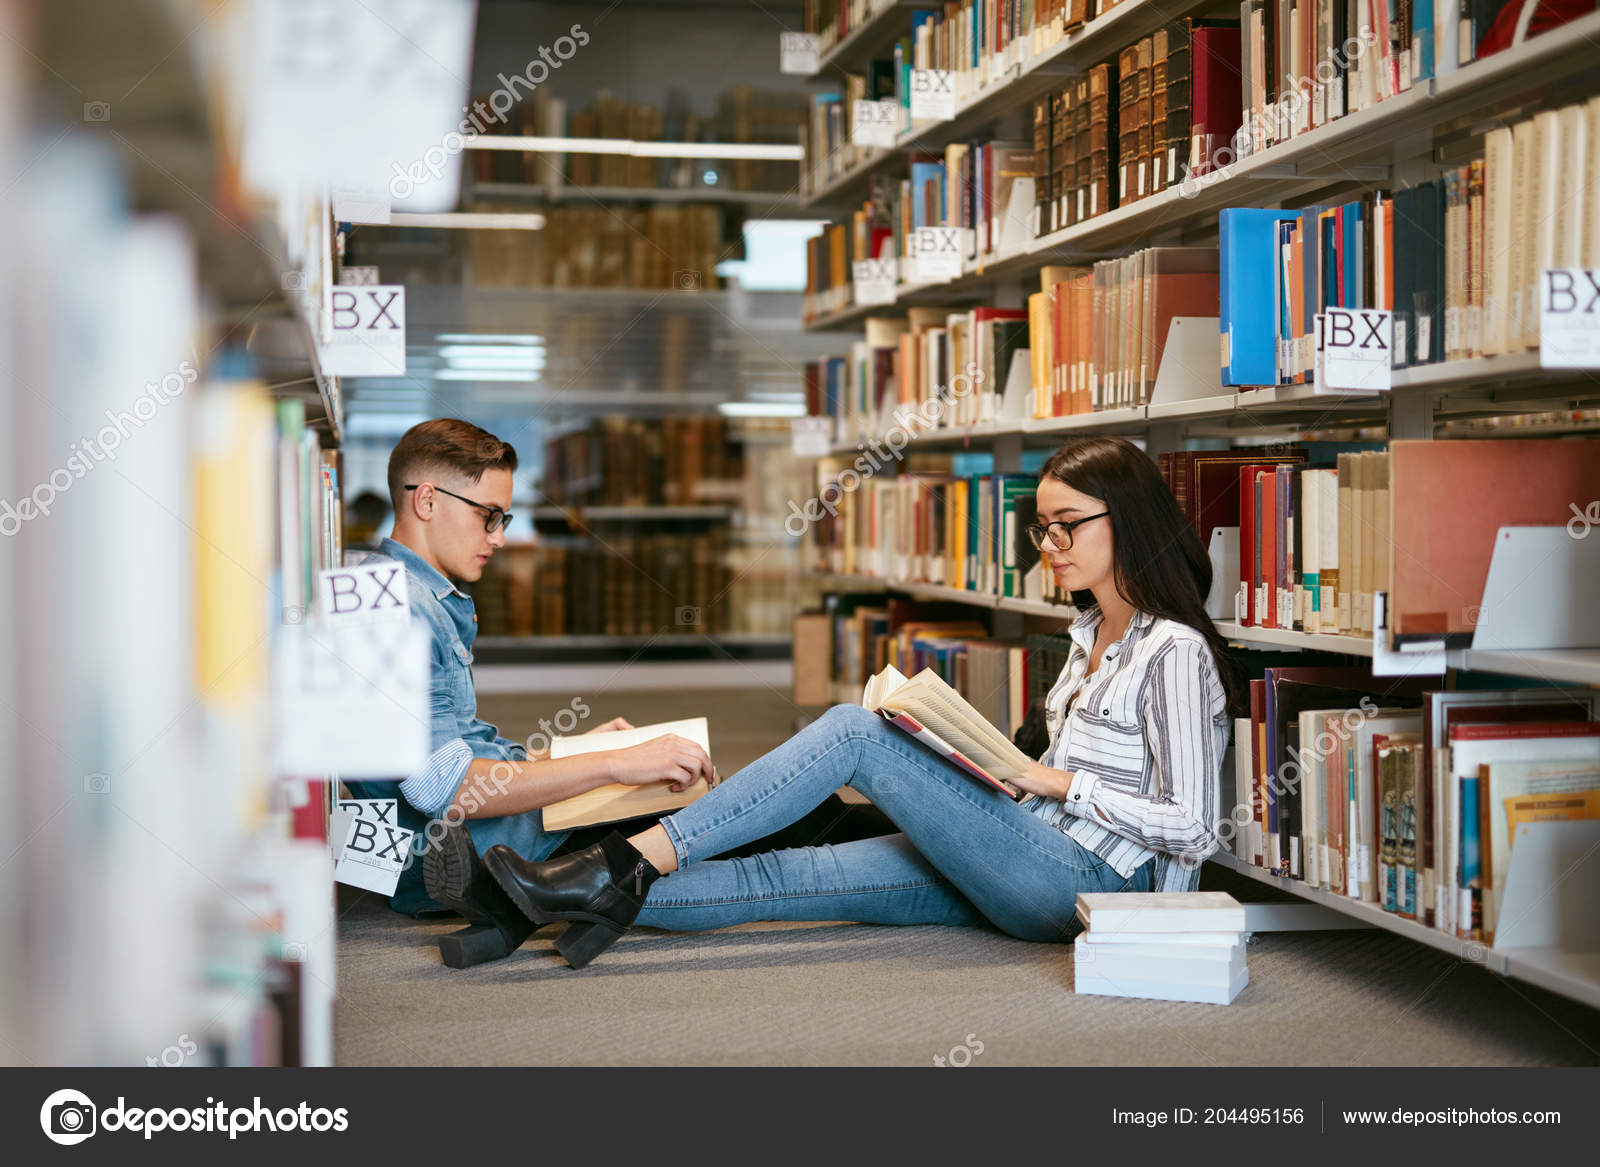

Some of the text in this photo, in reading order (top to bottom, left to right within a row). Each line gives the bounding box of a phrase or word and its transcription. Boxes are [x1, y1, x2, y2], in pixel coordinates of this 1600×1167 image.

[913, 70, 952, 93] BX
[919, 229, 958, 253] BX
[332, 291, 400, 330] BX
[1327, 311, 1388, 350] BX
[326, 568, 403, 614] BX
[346, 818, 410, 863] BX
